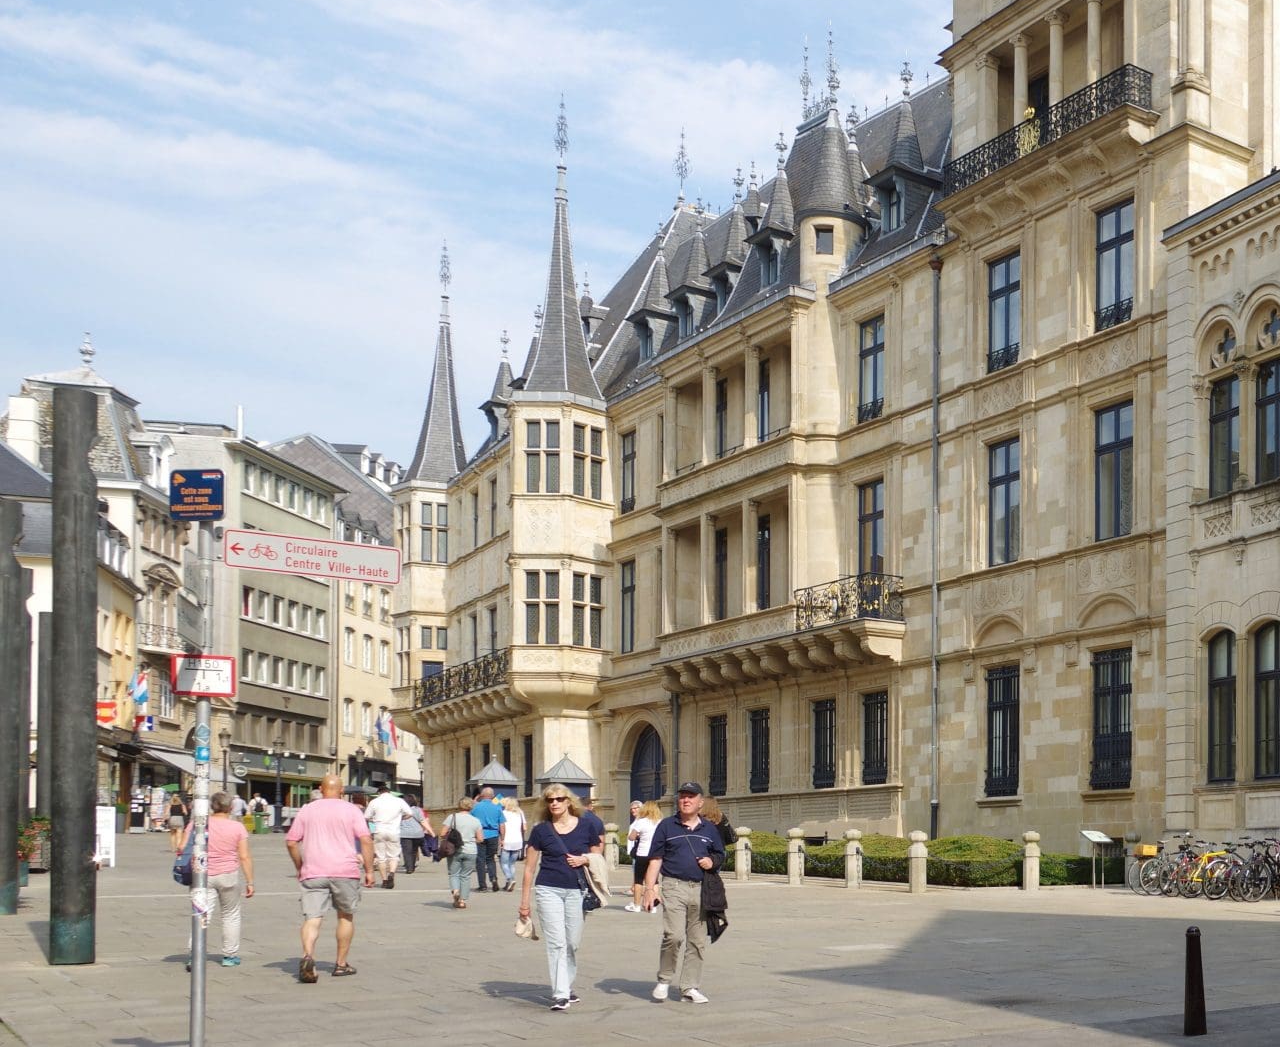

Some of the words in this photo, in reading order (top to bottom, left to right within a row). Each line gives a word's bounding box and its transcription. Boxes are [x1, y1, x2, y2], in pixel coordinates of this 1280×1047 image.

[285, 542, 338, 558] Circulaire
[285, 556, 321, 571] Centre
[328, 561, 389, 578] Ville-Haute
